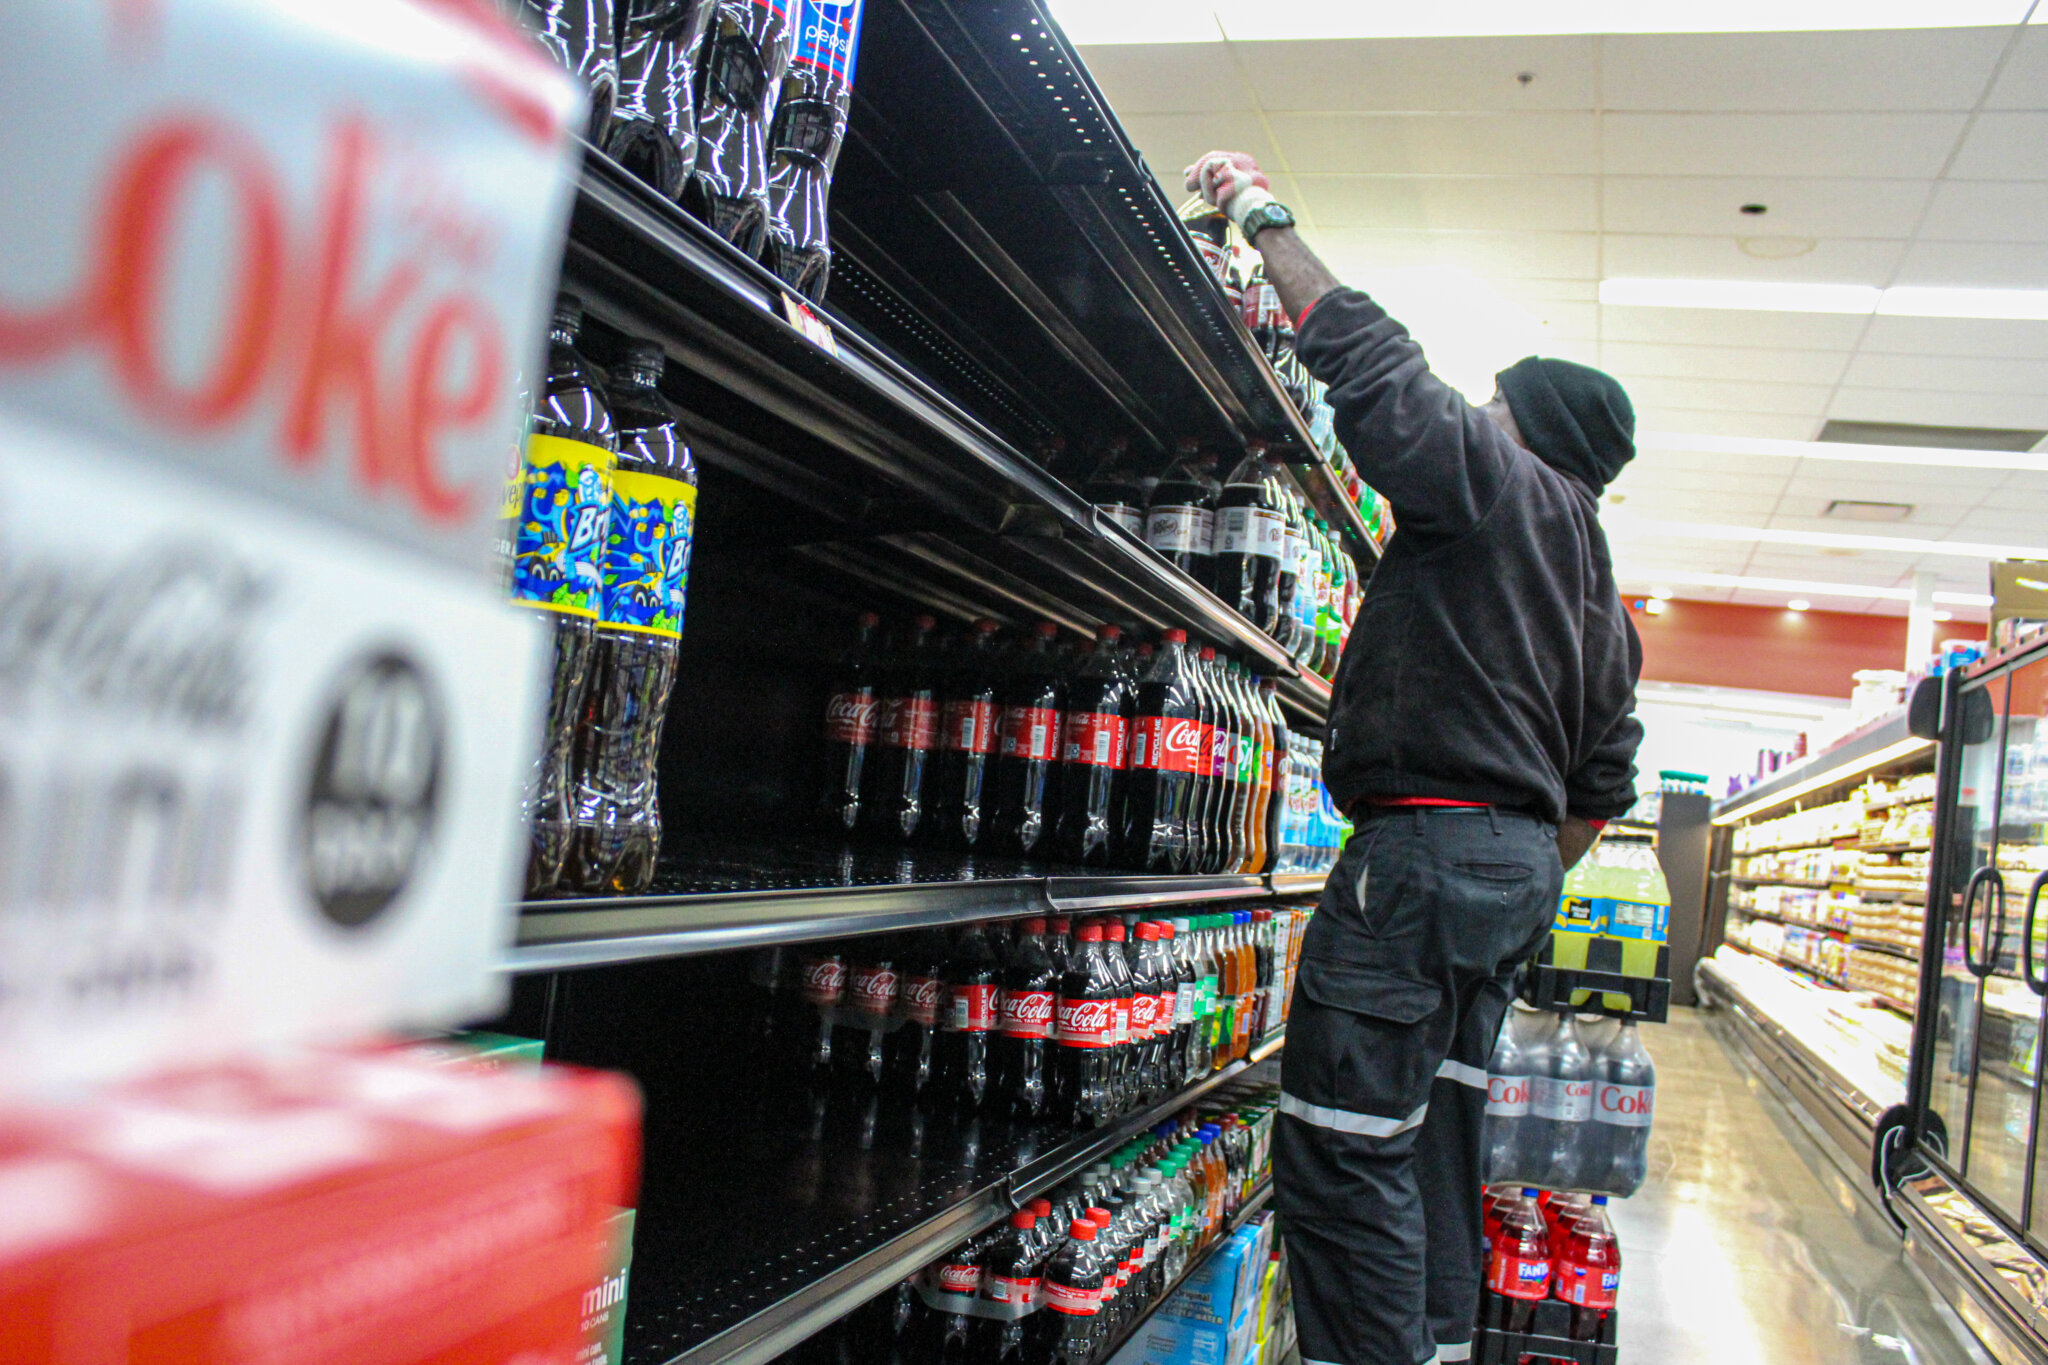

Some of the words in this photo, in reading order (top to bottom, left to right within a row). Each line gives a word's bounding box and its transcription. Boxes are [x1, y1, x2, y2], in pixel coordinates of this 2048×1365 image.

[0, 106, 514, 530] oke
[1118, 720, 1124, 732] ME
[1154, 719, 1161, 731] ME
[1116, 733, 1124, 766] RECYCLE
[1152, 732, 1161, 766] RECYCLE
[581, 1267, 627, 1317] mini
